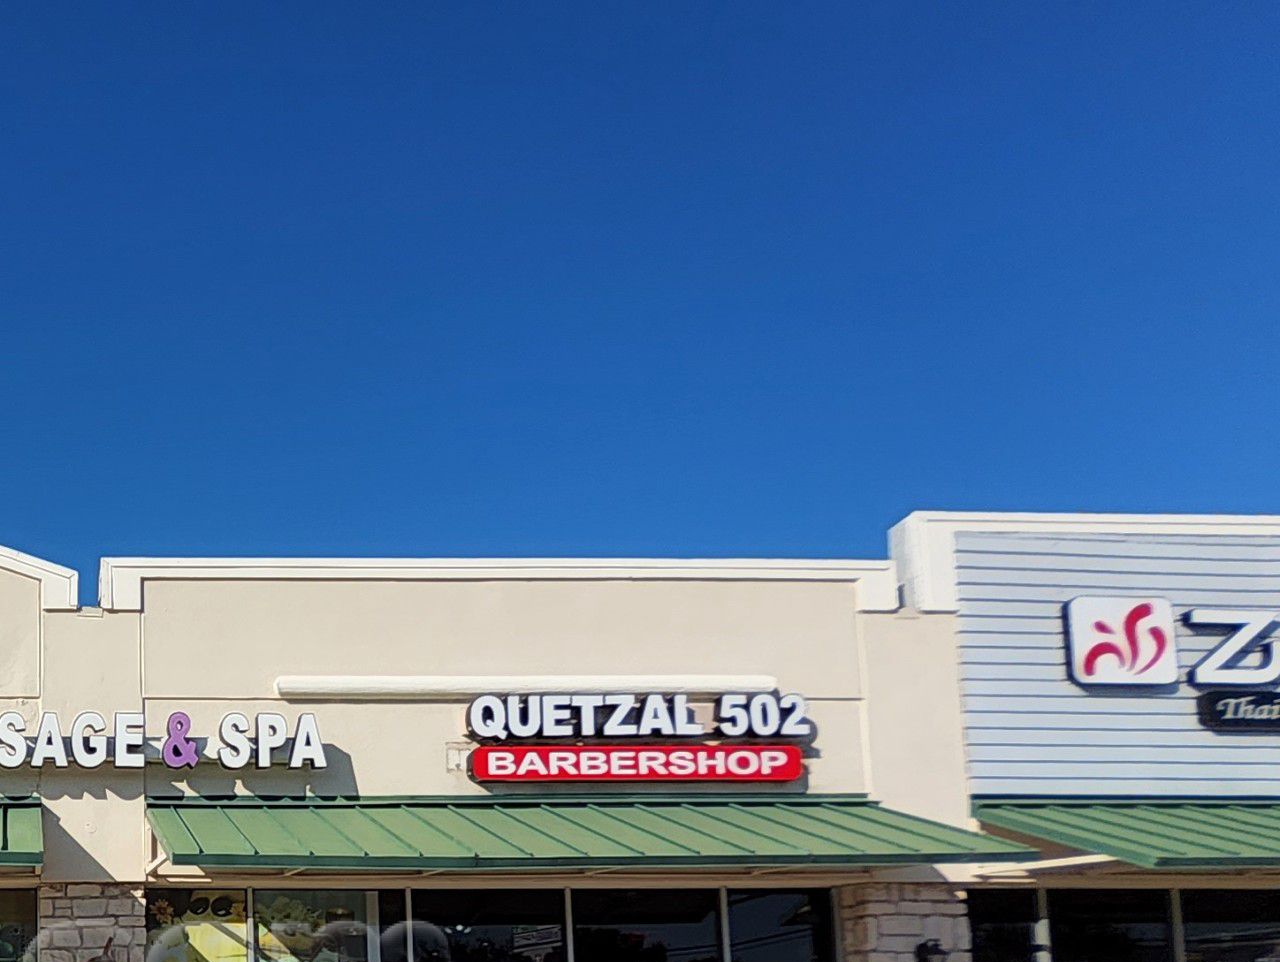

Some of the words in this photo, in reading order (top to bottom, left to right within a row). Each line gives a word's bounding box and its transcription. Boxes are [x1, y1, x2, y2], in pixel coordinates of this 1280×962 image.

[470, 695, 704, 739] QUETZAL
[720, 694, 811, 736] 502
[162, 711, 199, 769] &
[219, 712, 328, 769] SPA
[487, 752, 788, 775] BARBERSHOP
